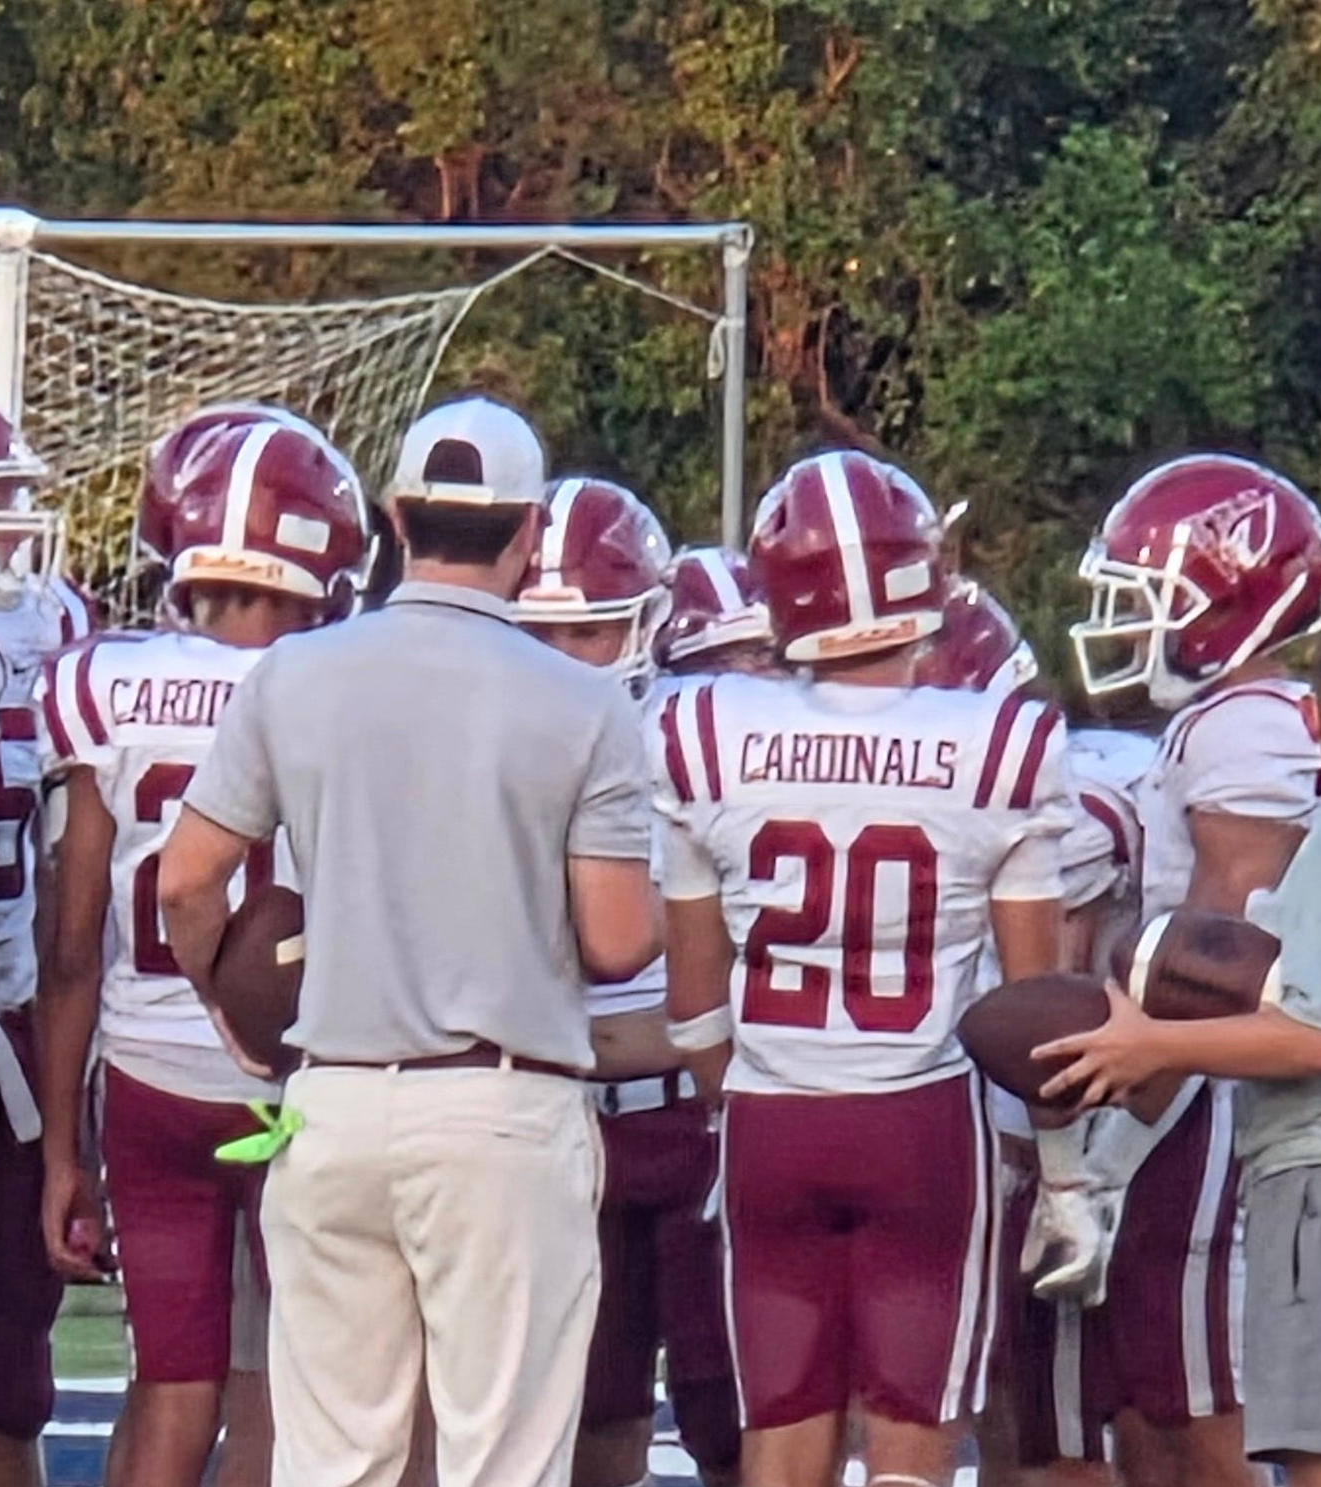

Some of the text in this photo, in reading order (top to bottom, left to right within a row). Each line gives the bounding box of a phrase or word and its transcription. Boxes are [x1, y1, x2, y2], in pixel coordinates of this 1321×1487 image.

[110, 678, 234, 726] CARDI
[740, 732, 958, 790] CARDINALS
[741, 819, 938, 1033] 20
